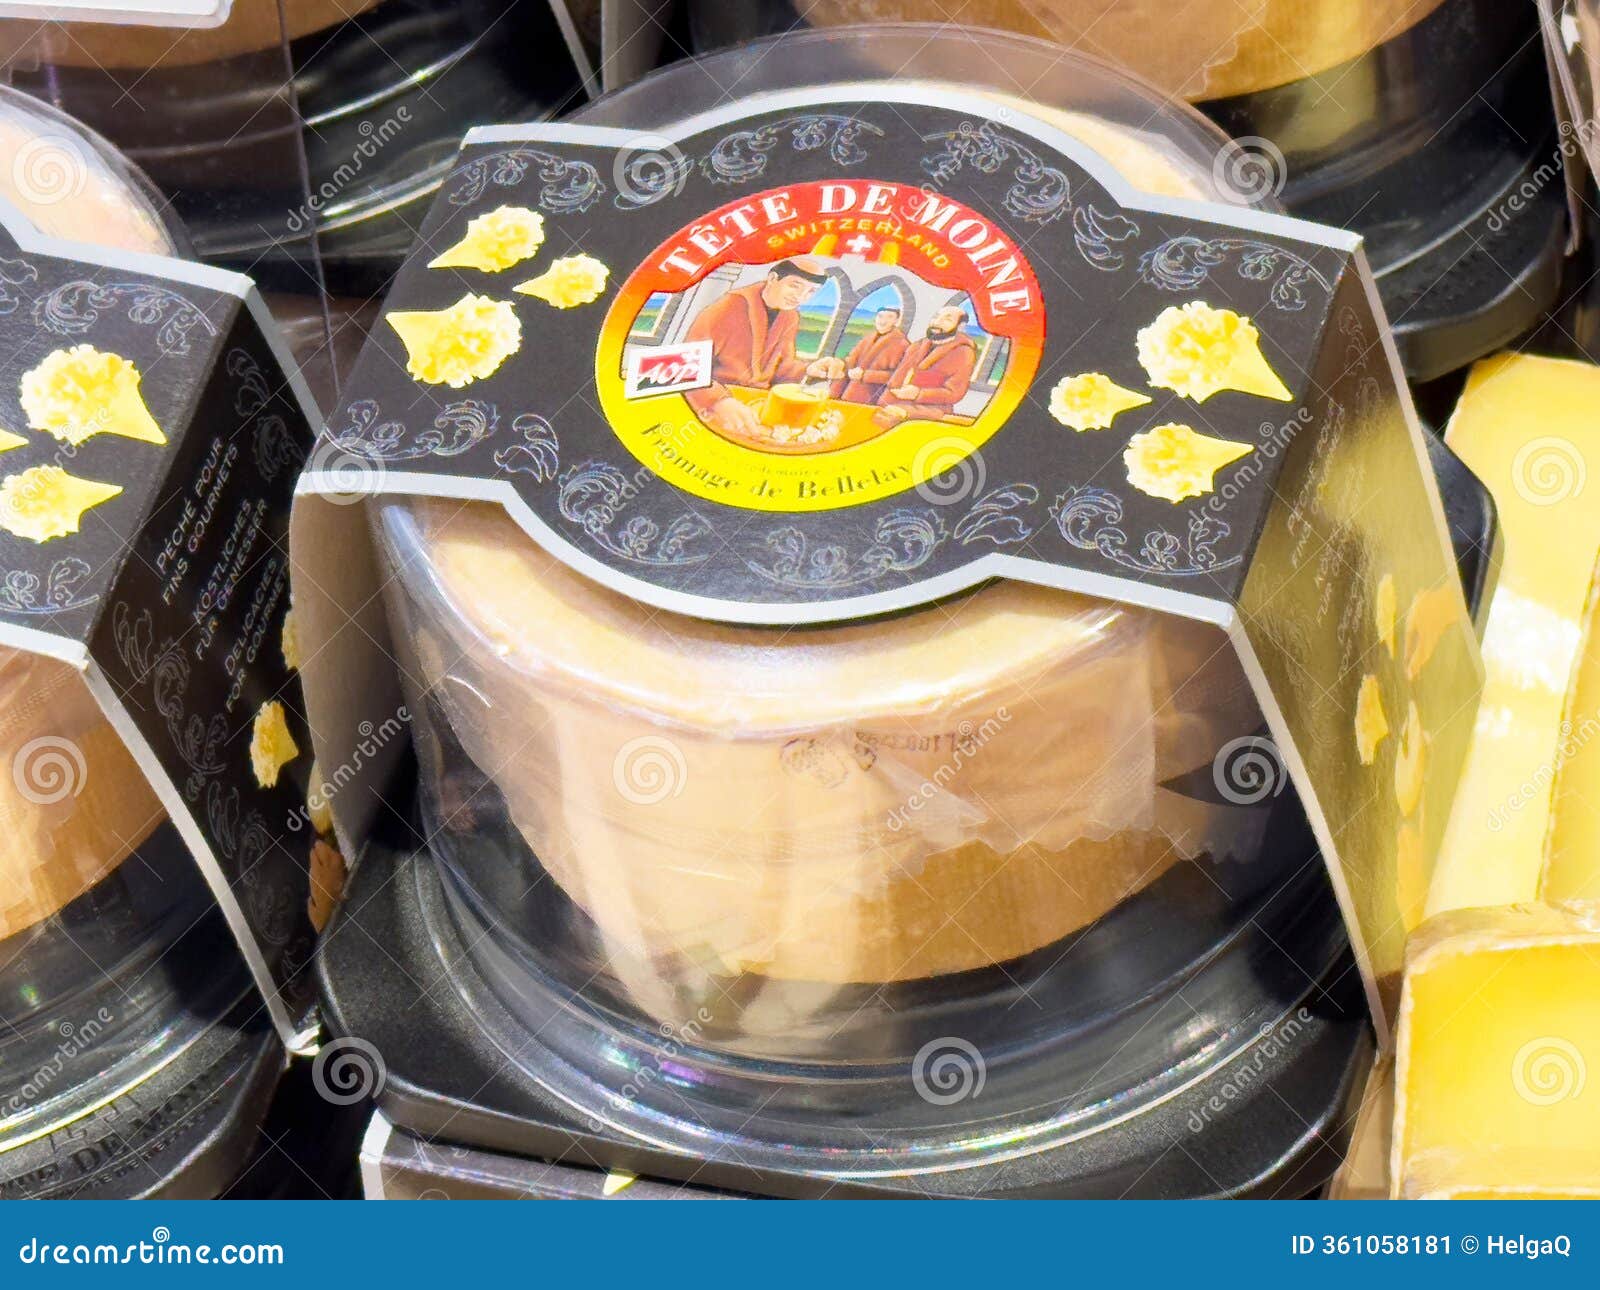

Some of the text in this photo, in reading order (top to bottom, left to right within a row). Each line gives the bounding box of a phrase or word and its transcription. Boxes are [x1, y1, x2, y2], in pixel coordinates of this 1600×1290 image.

[659, 184, 1031, 316] TÊTE DE MOINE
[767, 218, 950, 268] SWITZERLAND
[156, 437, 224, 574] PÉCHÉ POUR
[641, 423, 740, 488] Fromage
[750, 479, 782, 499] de
[162, 443, 238, 606] FINS GOURMETS
[192, 500, 252, 625] KÖSTLICHES
[195, 498, 268, 661] FÜR GENIESSER
[224, 557, 277, 676] DELICACIES
[226, 668, 247, 713] FOR
